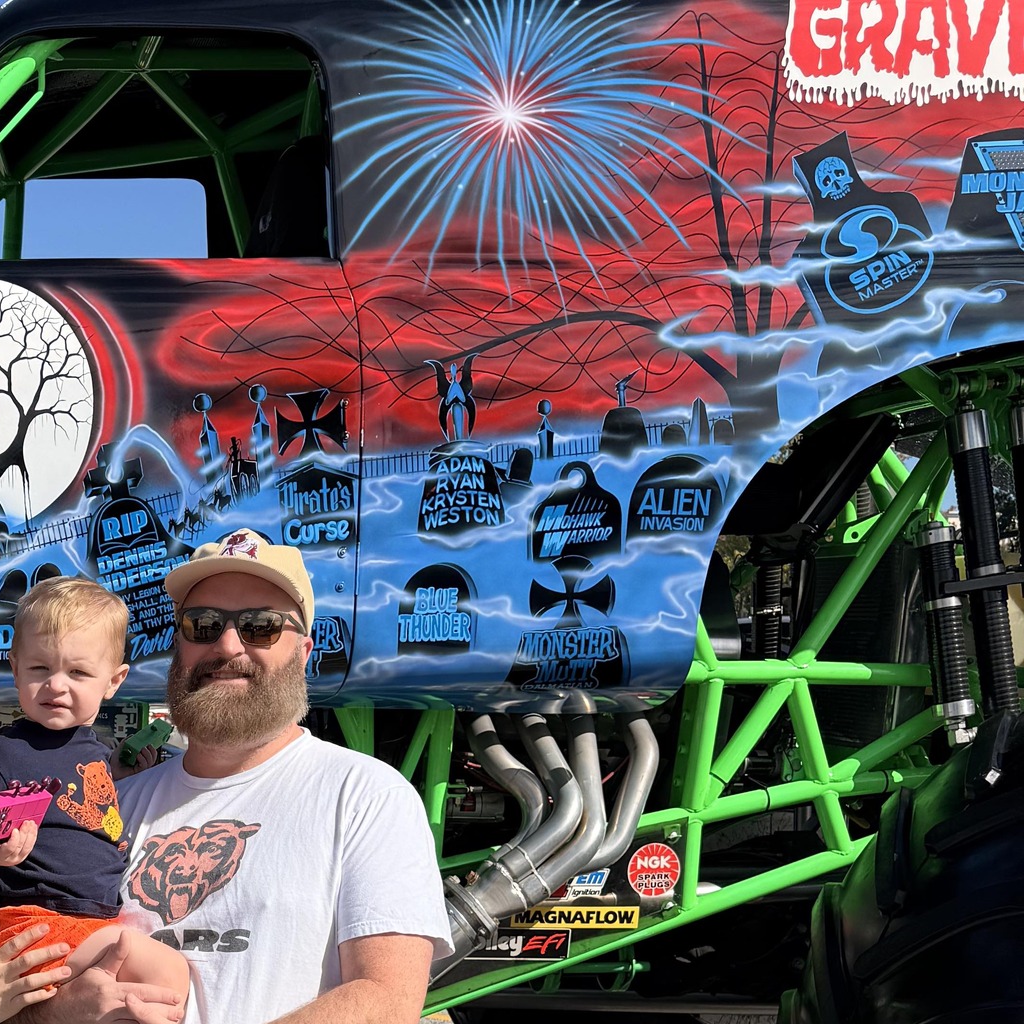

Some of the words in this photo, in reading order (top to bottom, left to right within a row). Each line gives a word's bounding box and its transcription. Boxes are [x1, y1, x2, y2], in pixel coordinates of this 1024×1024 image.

[849, 250, 912, 291] SPIN
[436, 457, 485, 474] ADAM
[280, 477, 352, 517] Pirate's
[435, 476, 485, 494] RYAN
[422, 491, 501, 514] KRYSTEN
[636, 488, 711, 516] ALIEN
[101, 510, 148, 541] RIP
[424, 507, 501, 531] WESTON
[640, 517, 705, 531] INVASION
[284, 518, 350, 546] Curse
[539, 527, 613, 557] WARRIOR
[97, 541, 168, 575] DENNIS
[96, 553, 190, 593] NDERSON
[133, 585, 161, 600] LEGION
[414, 587, 459, 613] BLUE
[139, 608, 156, 620] AND
[398, 612, 471, 643] THUNDER
[521, 630, 616, 661] MONSTER
[637, 856, 671, 869] NGK
[637, 873, 670, 881] SPARK
[637, 881, 670, 889] PLUGS
[571, 888, 600, 898] Ignition
[514, 910, 634, 924] MAGNAFLOW
[153, 929, 250, 953] ARS
